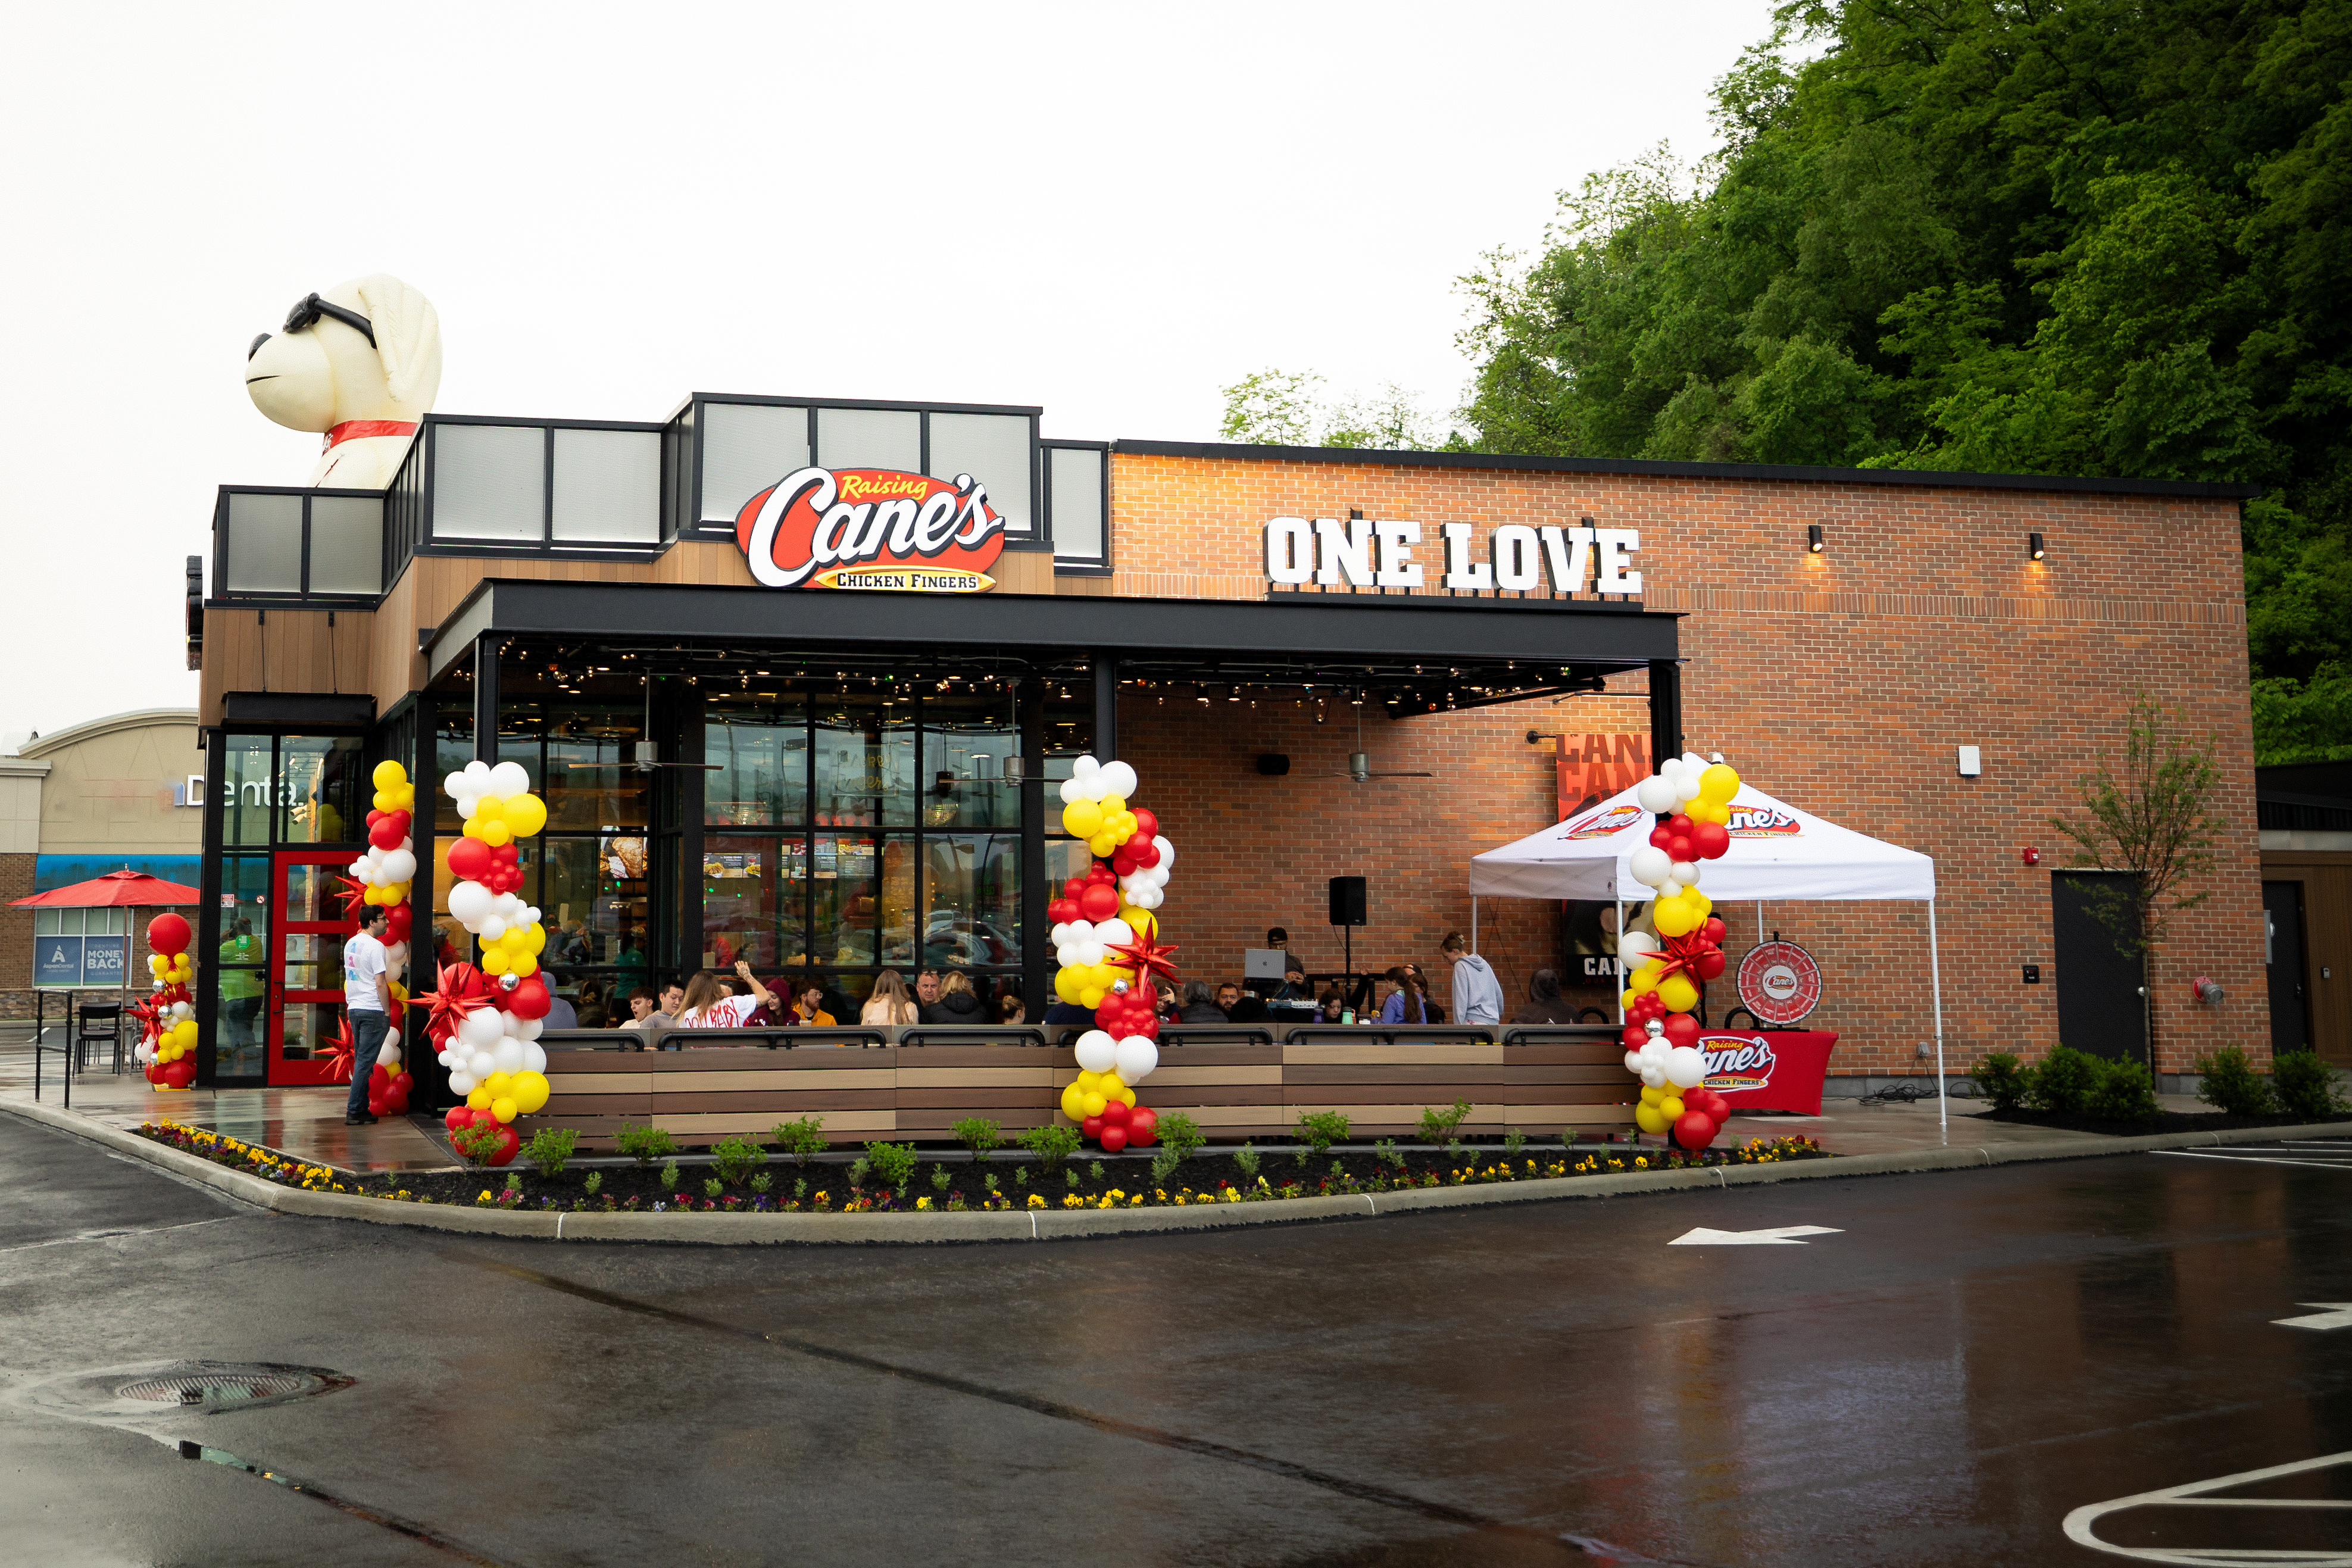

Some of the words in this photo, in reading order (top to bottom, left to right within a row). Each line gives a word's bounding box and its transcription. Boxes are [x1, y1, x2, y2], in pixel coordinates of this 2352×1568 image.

[839, 474, 928, 500] Raising
[748, 466, 1005, 588] Cane's
[1262, 516, 1423, 588] ONE
[1439, 522, 1643, 594] LOVE
[837, 573, 904, 588] CHICKEN
[911, 573, 977, 588] FINGERS
[1556, 734, 1653, 763] CAN
[1557, 763, 1653, 801] CAN
[87, 958, 123, 969] BACK
[1706, 1041, 1744, 1051] Raising
